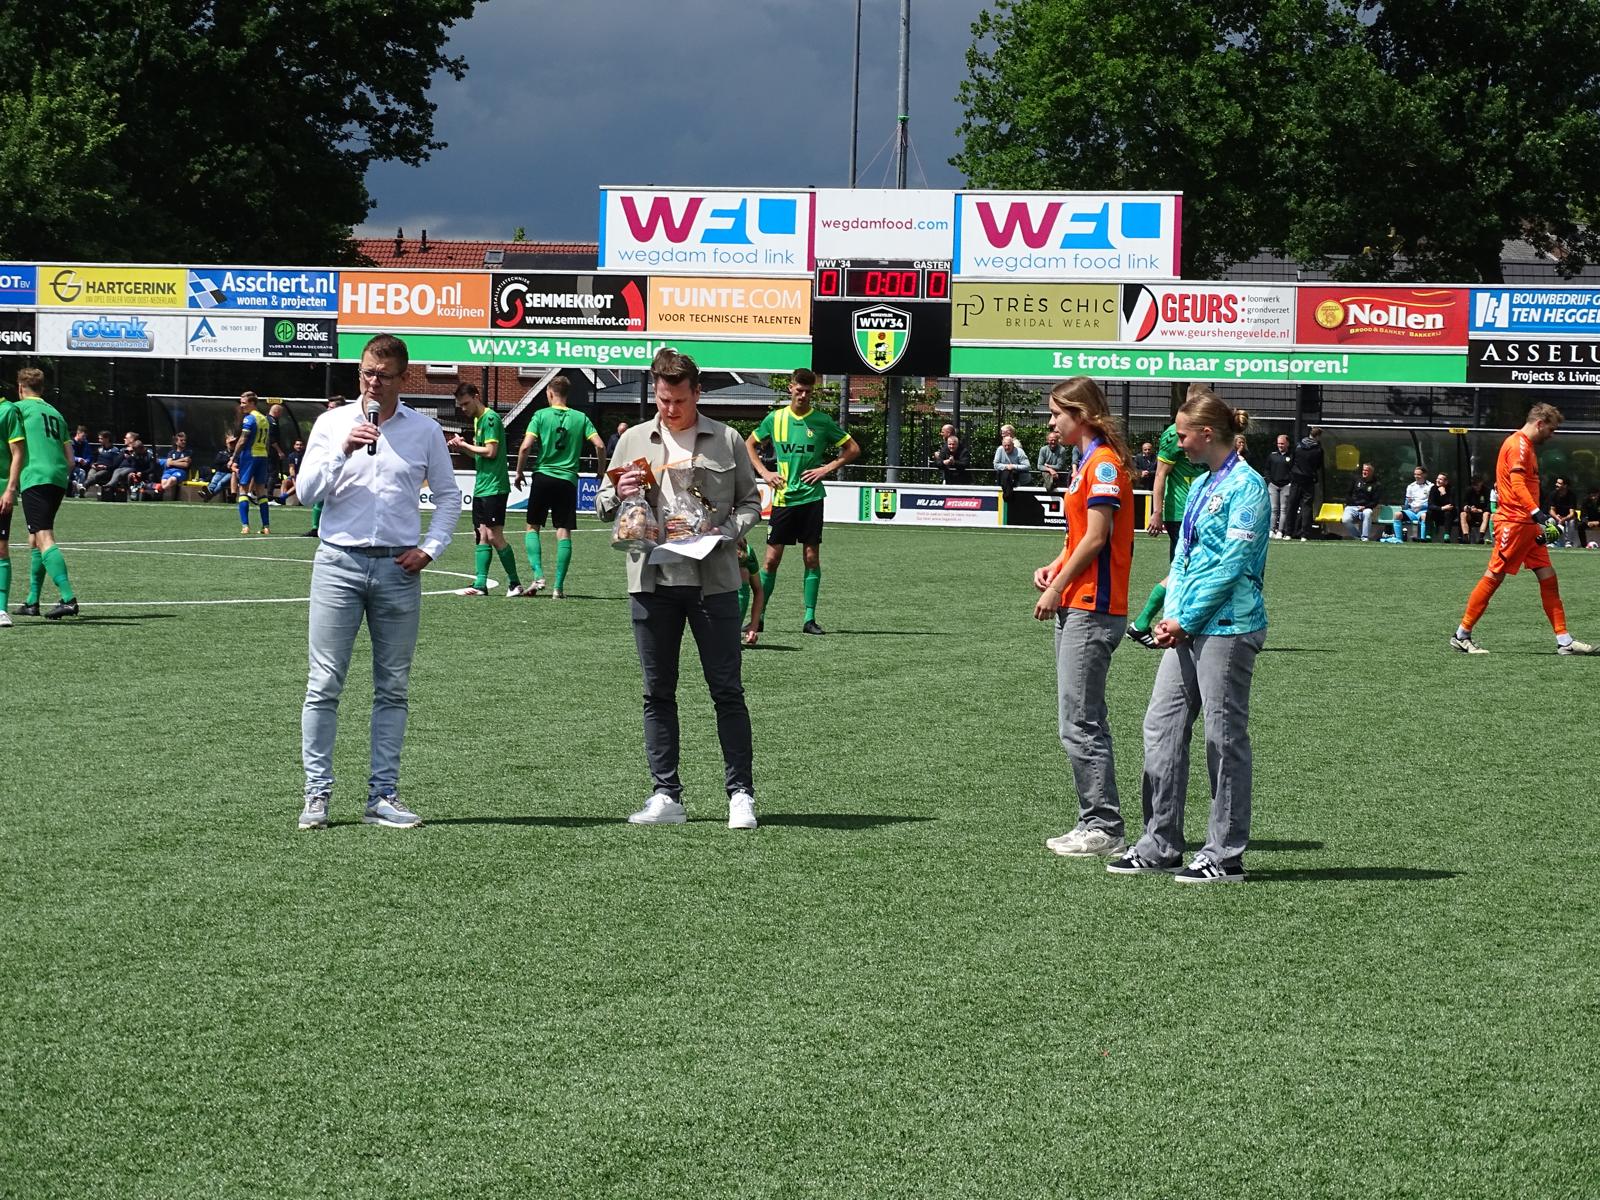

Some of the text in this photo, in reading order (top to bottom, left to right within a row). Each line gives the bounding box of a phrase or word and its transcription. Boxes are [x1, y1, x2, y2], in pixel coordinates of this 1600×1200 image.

[821, 217, 949, 232] wegdamfood.com
[617, 247, 795, 266] wegdam food link
[817, 260, 851, 268] WVV '34
[973, 253, 1160, 271] wegdam food link
[913, 261, 950, 269] GASTEN
[86, 281, 177, 296] HARTGERINK
[221, 271, 337, 294] Asschert.nl
[821, 270, 838, 295] 0
[865, 271, 918, 296] 0:00
[929, 272, 947, 296] 0
[237, 296, 327, 309] wonen & projecten
[342, 282, 462, 315] HEBO.nl
[525, 293, 614, 309] SEMMEKROT
[659, 286, 801, 310] TUINTE.COM
[993, 293, 1115, 314] TRÈS CHIC
[1247, 294, 1280, 303] loonwerk
[1512, 293, 1592, 305] BOUWBEDRIJF
[437, 303, 485, 320] kozijnen
[1161, 292, 1238, 324] GEURS
[1247, 306, 1290, 316] grondverzet
[1512, 308, 1542, 322] TEN
[525, 315, 642, 327] www.semmekrot.com
[658, 312, 801, 325] VOOR TECHNISCHE TALENTEN
[860, 317, 904, 329] WVV'34
[1006, 318, 1100, 328] BRIDAL WEAR
[1247, 316, 1280, 326] transport
[1345, 303, 1445, 330] Nollen
[297, 323, 318, 332] RICK
[1160, 327, 1290, 340] www.geurshengevelde.nl
[0, 331, 31, 345] GiNG
[297, 332, 328, 341] BONKE
[190, 344, 261, 354] Terrasschermen
[556, 340, 678, 363] Hengeveld
[1053, 352, 1349, 378] Is trots op haar sponsoren!
[1511, 371, 1554, 384] Projects
[1557, 371, 1566, 382] &
[41, 412, 60, 440] 10
[555, 427, 568, 450] 2
